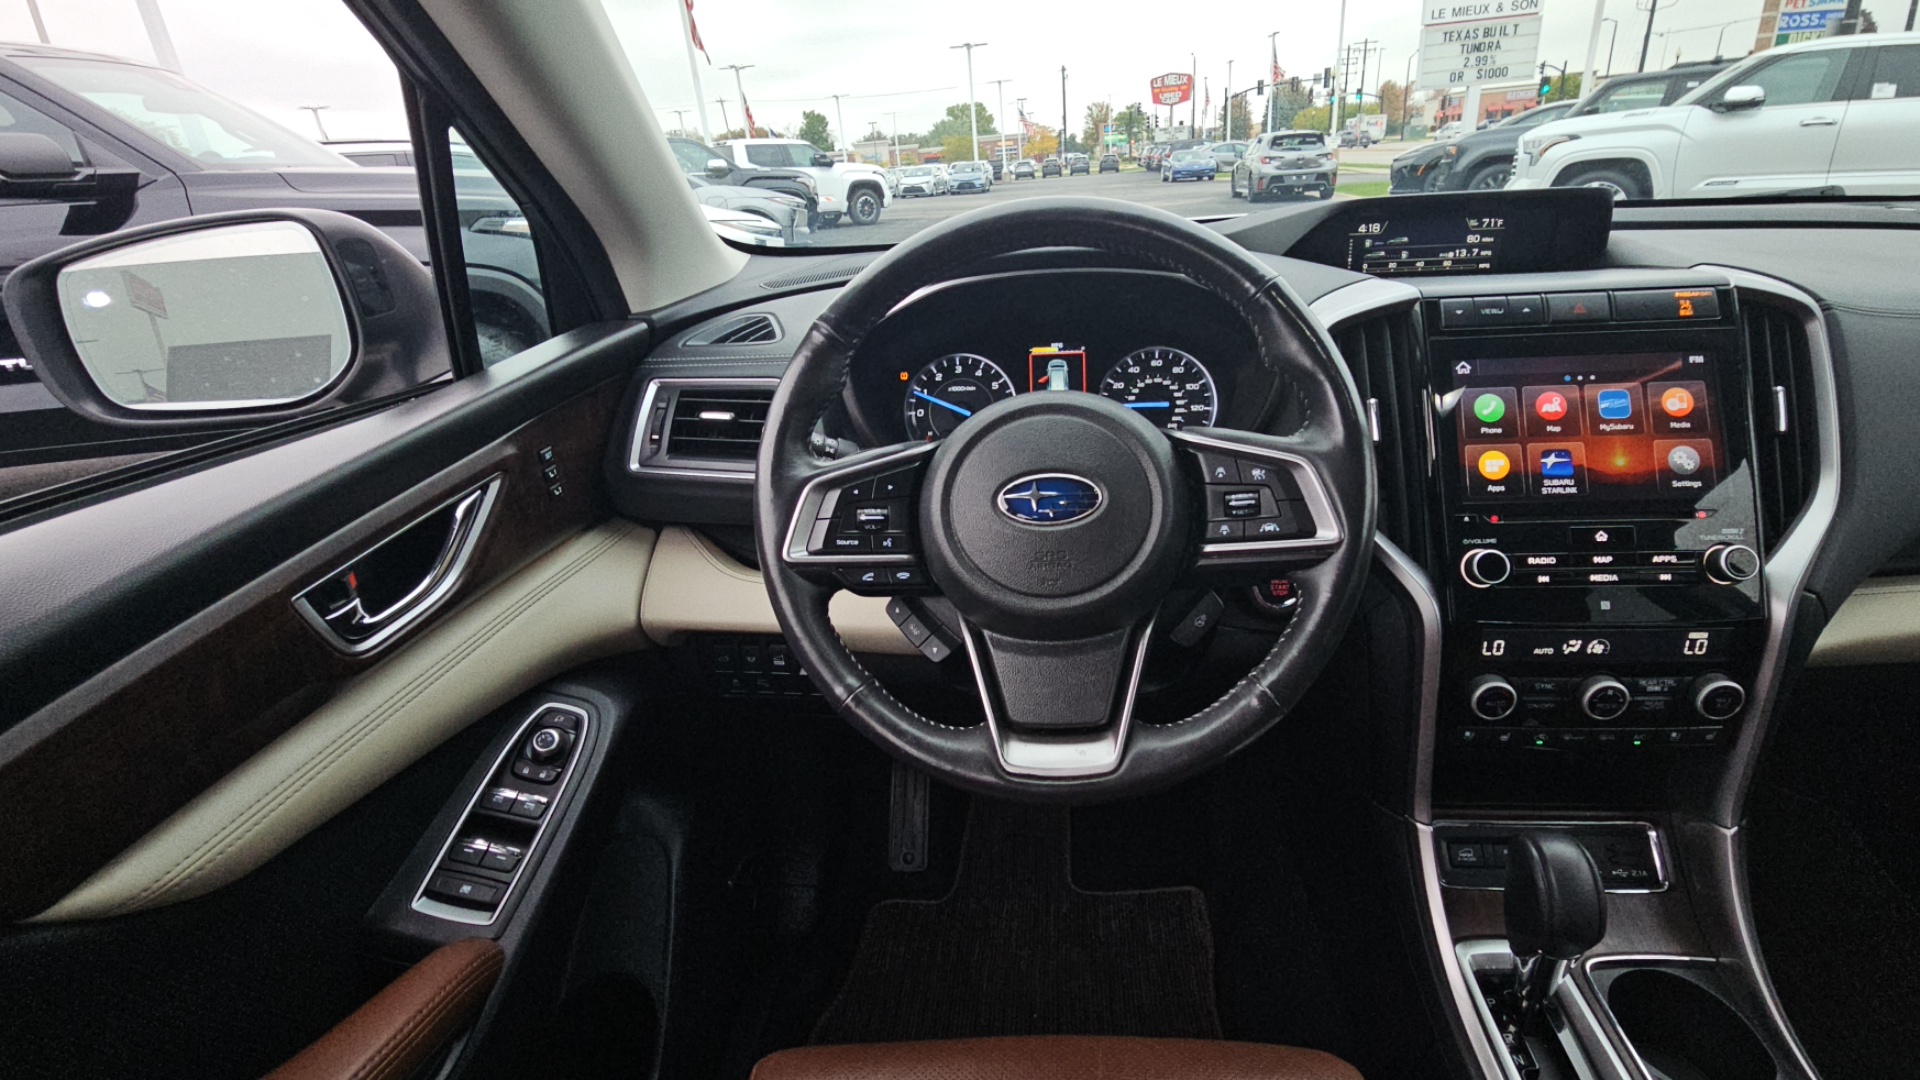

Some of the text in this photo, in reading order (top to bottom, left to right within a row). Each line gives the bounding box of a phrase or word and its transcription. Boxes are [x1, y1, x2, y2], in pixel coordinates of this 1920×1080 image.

[1431, 0, 1539, 20] LE MIEUX & SON
[1442, 23, 1520, 43] TEXAS BUILT
[1460, 40, 1502, 55] TUNDRA
[1153, 74, 1188, 88] LE MIEUX
[1449, 71, 1464, 83] OR
[1358, 222, 1381, 233] 4:18
[1467, 234, 1481, 243] 80
[1455, 248, 1479, 258] 13.7
[1150, 359, 1163, 367] 60
[954, 365, 962, 374] 3
[974, 369, 983, 377] 4
[1172, 366, 1185, 374] 80
[935, 373, 943, 382] 2
[991, 381, 1000, 390] 5
[1185, 383, 1200, 391] 100
[916, 408, 925, 417] 0
[1190, 404, 1205, 412] 120
[1546, 425, 1562, 433] Map
[1599, 423, 1635, 432] MySubaru
[1669, 421, 1692, 429] Media
[1480, 427, 1503, 435] Phone
[1543, 479, 1575, 487] SUBARU
[1671, 480, 1703, 489] Settings
[1487, 484, 1506, 493] Apps
[1541, 487, 1578, 495] STARLINK
[1527, 556, 1557, 565] RADIO
[1592, 555, 1614, 564] MAP
[1652, 555, 1678, 563] APPS
[1589, 573, 1619, 582] MEDIA
[1533, 647, 1555, 655] AUTO
